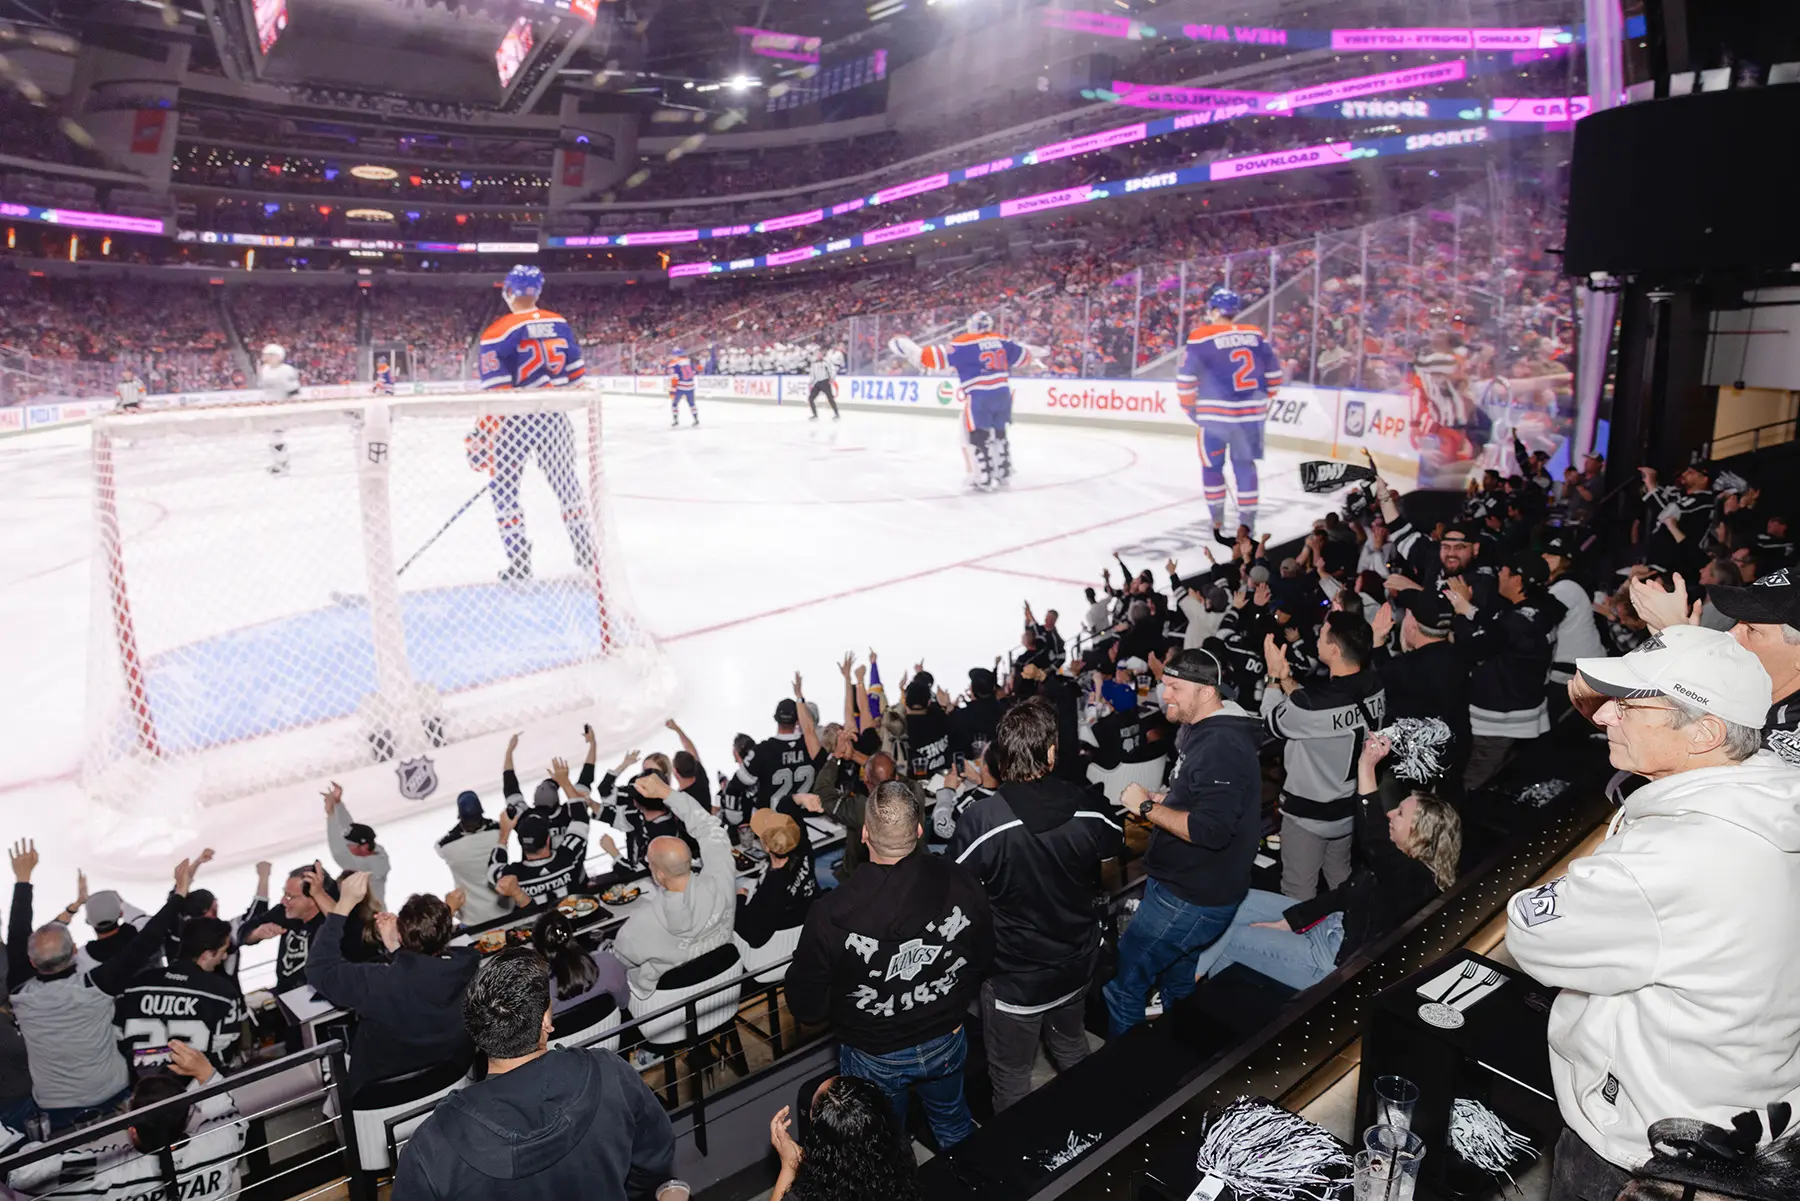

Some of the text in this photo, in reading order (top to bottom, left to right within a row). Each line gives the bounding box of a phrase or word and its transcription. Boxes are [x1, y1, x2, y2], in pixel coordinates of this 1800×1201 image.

[1174, 111, 1211, 129] NEW
[1405, 126, 1488, 150] SPORTS
[1235, 151, 1320, 172] DOWNLOAD
[1124, 172, 1178, 192] SPORTS
[1017, 193, 1072, 211] DOWNLOAD
[517, 337, 569, 385] 25
[1229, 346, 1259, 392] 2
[851, 379, 919, 402] PIZZA 73
[1047, 386, 1167, 414] Scotiabank
[1368, 408, 1405, 438] App
[1673, 683, 1710, 706] Reebok
[522, 872, 573, 896] KOPITAR
[889, 947, 937, 975] KINGS
[140, 994, 200, 1016] QUICK
